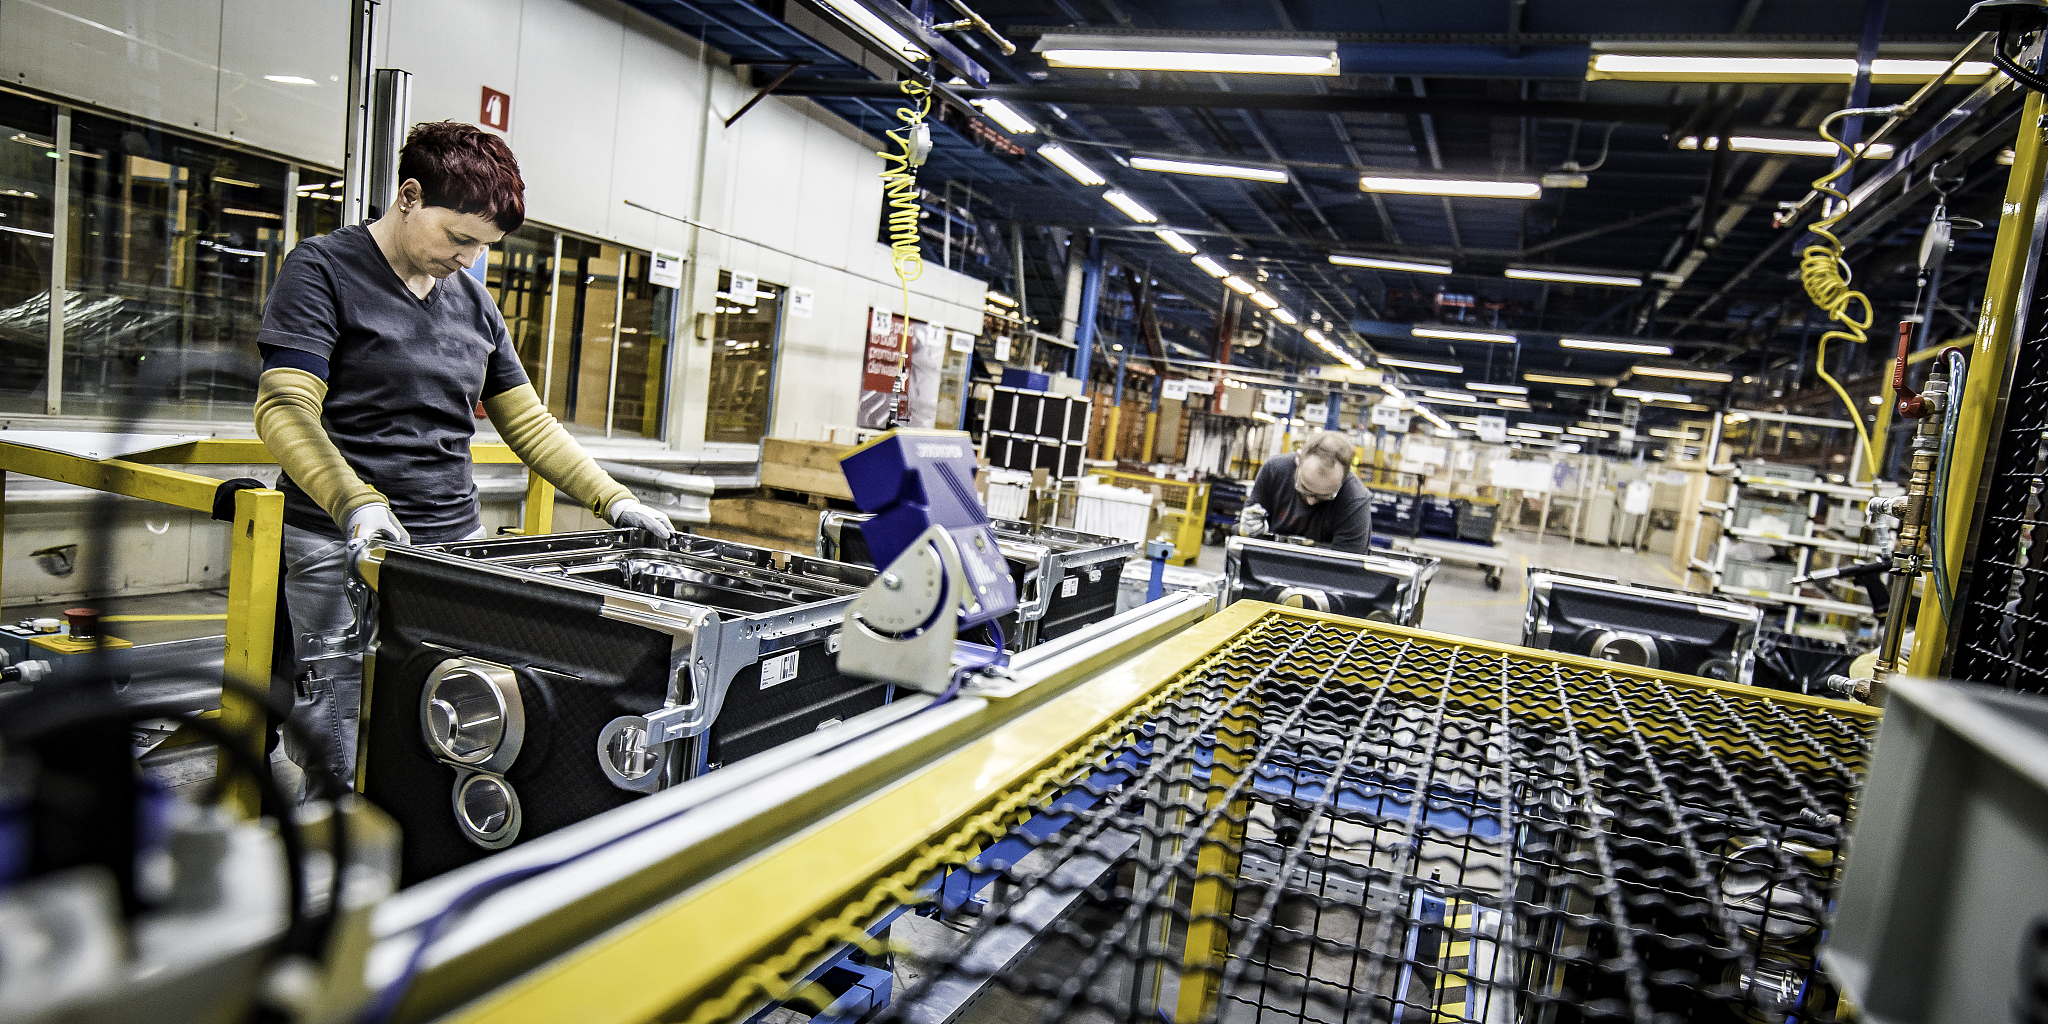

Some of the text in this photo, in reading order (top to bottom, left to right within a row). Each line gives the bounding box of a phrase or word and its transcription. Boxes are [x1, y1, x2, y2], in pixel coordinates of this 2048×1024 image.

[894, 322, 914, 337] prod
[871, 333, 898, 348] to build
